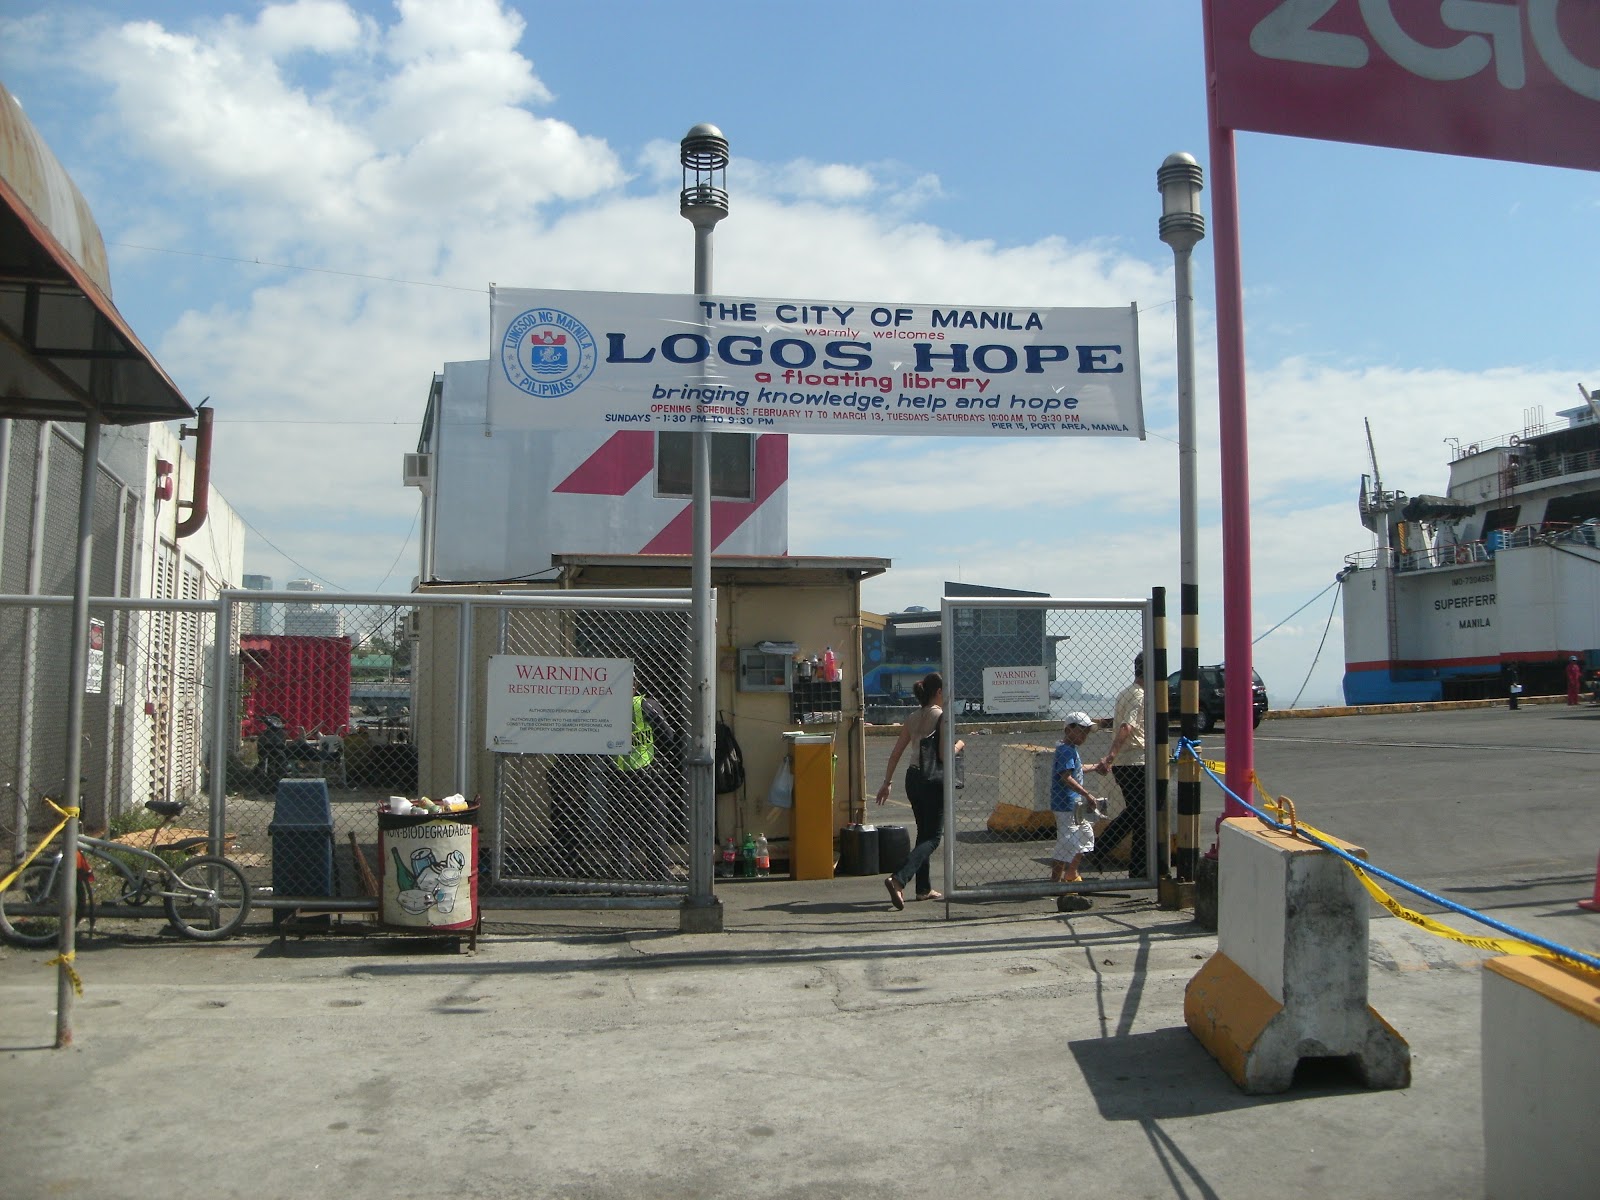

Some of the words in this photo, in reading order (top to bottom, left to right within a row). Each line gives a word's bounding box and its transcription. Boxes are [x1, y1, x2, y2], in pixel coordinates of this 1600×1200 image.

[699, 301, 756, 321] THE
[775, 304, 855, 325] CITY
[870, 307, 913, 327] OF
[931, 309, 1043, 330] MANILA
[505, 314, 537, 349] LUNGSOD
[538, 311, 553, 323] NG
[556, 313, 593, 350] MAYNILA
[805, 327, 860, 340] warmly
[873, 329, 945, 340] welcomes
[605, 333, 873, 371] LOGOS
[913, 343, 1124, 374] HOPE
[519, 378, 574, 395] PILIPINAS
[754, 372, 772, 383] a
[781, 369, 893, 393] floating
[902, 373, 991, 393] library
[652, 384, 750, 406] bringing
[757, 387, 890, 411] knowledge,
[897, 393, 947, 413] help
[955, 394, 1001, 409] and
[1009, 394, 1079, 413] hope
[605, 413, 651, 422] SUNDAYS
[690, 415, 706, 423] PM
[711, 415, 723, 424] TO
[728, 416, 753, 424] 9:30
[758, 417, 774, 425] PM
[650, 404, 692, 413] OPENING
[696, 405, 749, 415] SCHEDULES:
[753, 408, 801, 418] FEBRUARY
[817, 411, 828, 419] TO
[833, 411, 867, 420] MARCH
[871, 412, 884, 422] 13,
[1027, 414, 1037, 422] TO
[1041, 414, 1062, 422] 9:30
[992, 422, 1013, 430] PIER
[1061, 423, 1090, 431] AREA,
[1092, 424, 1129, 432] MANILA
[1434, 594, 1497, 610] SUPERFERR
[1459, 618, 1491, 629] MANILA
[516, 664, 608, 682] WARNING
[994, 670, 1036, 679] WARNING
[508, 684, 580, 696] RESTRICTED
[582, 686, 613, 696] AREA
